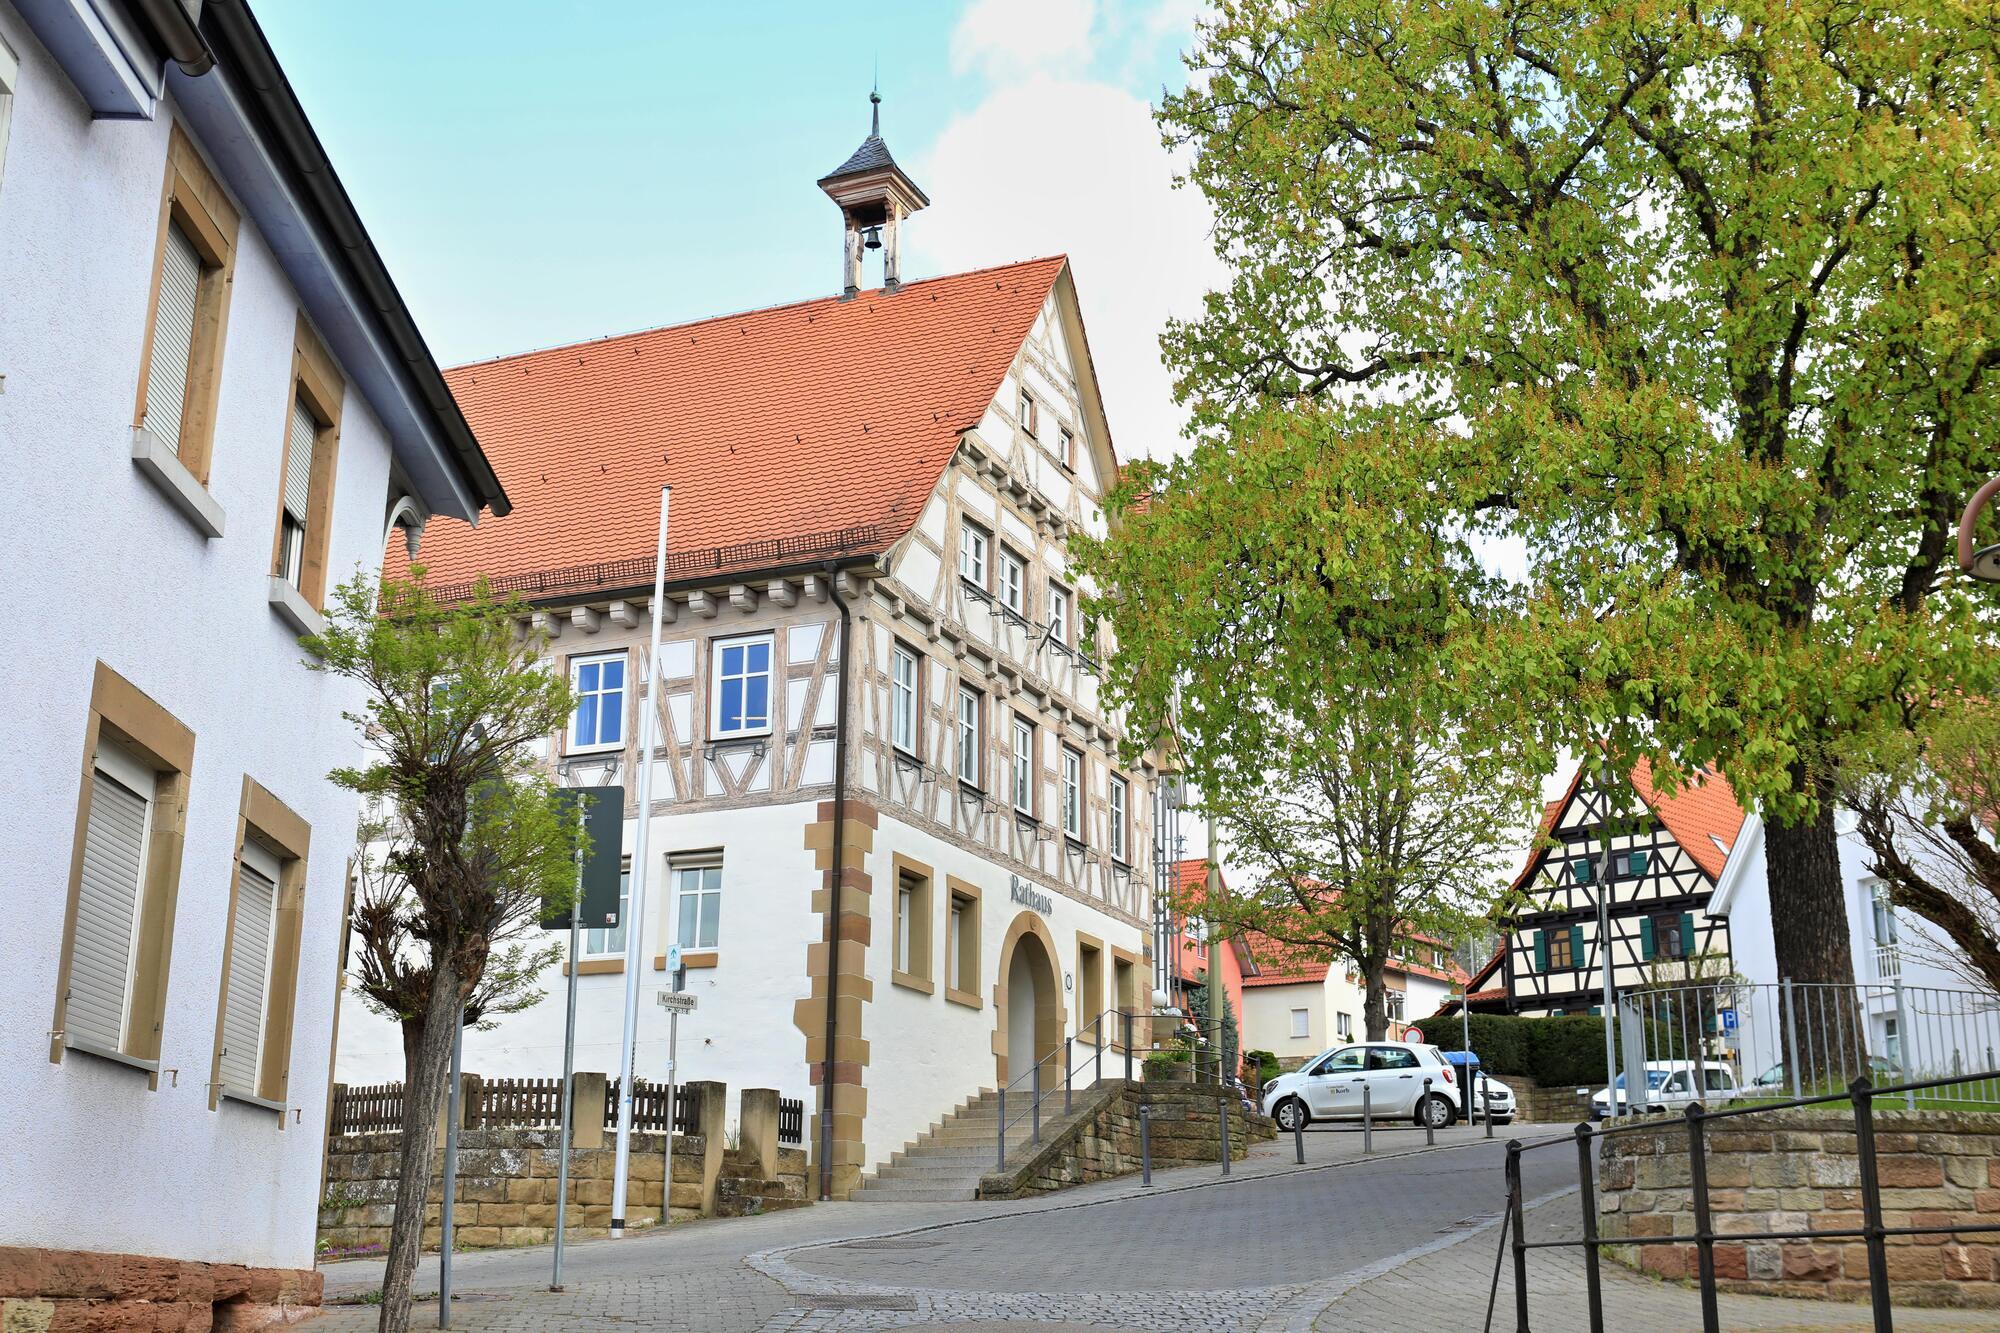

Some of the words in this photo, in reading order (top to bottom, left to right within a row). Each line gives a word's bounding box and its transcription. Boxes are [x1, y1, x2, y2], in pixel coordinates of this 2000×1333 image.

[1010, 874, 1052, 916] Rathaus
[662, 994, 694, 1006] Kirchstraße
[1726, 1012, 1735, 1027] P
